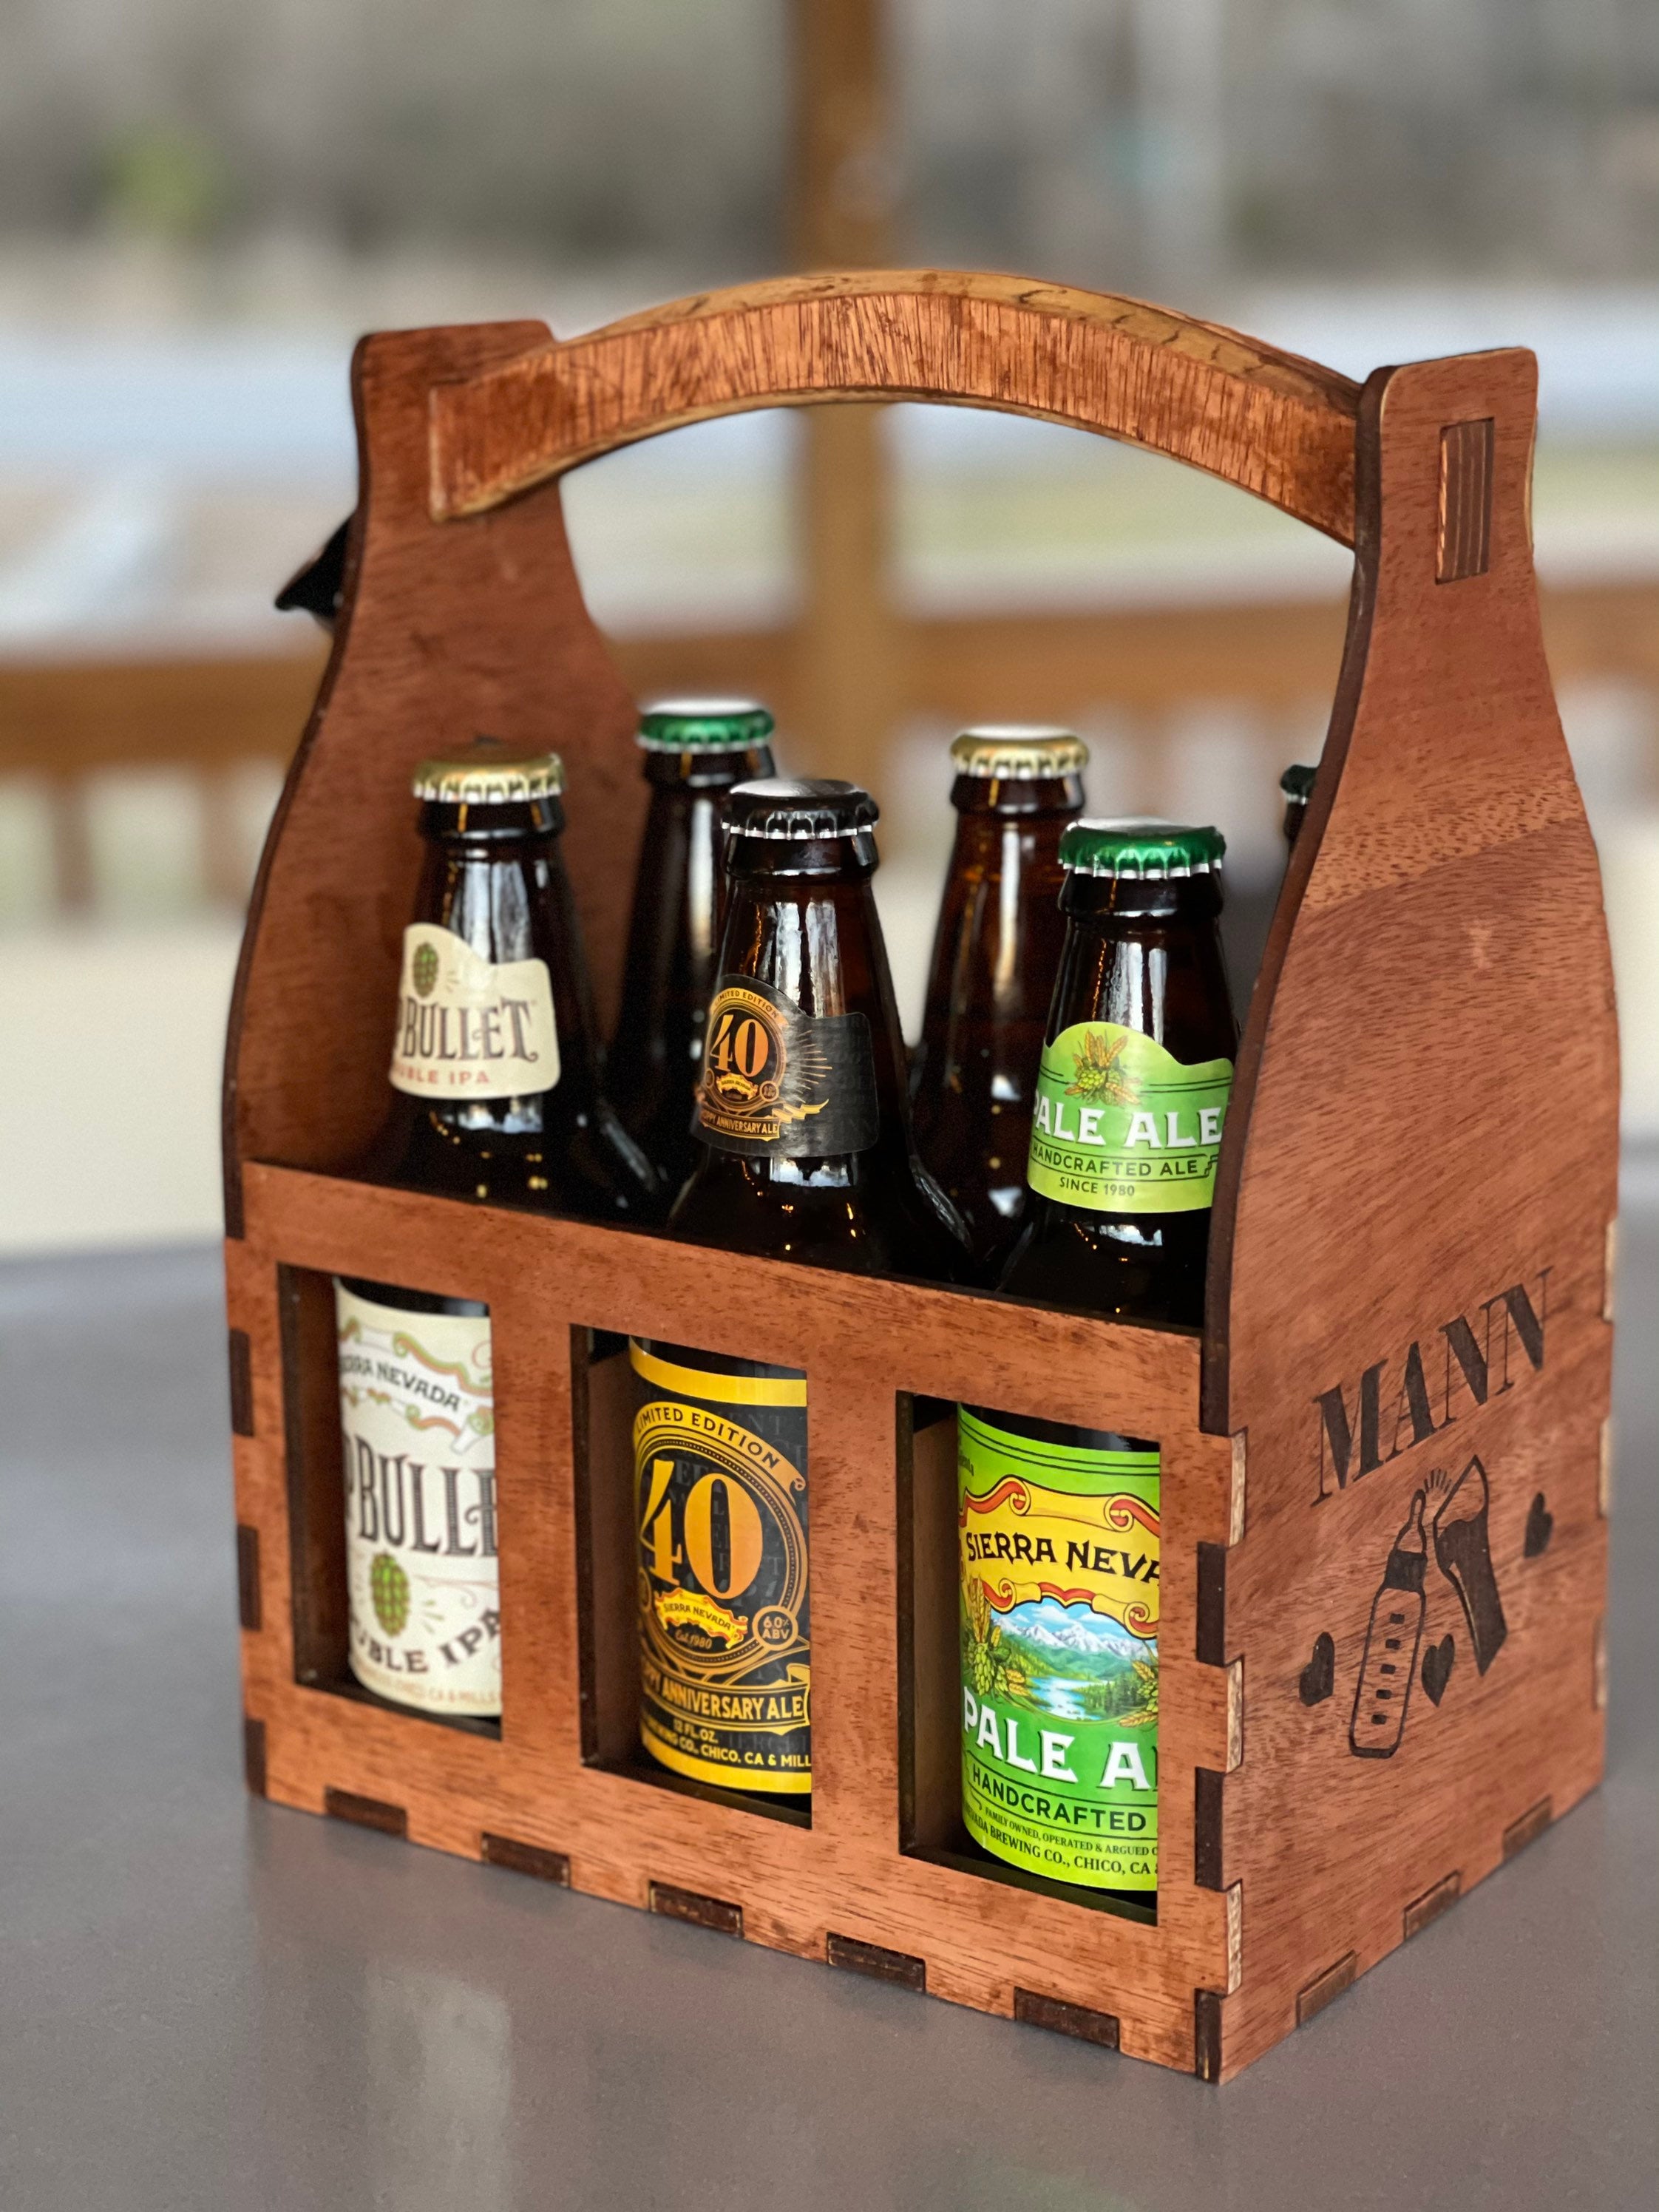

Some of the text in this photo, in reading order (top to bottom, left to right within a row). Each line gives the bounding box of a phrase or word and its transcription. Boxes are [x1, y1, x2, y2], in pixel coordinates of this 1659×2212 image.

[742, 992, 779, 1019] EDITION
[402, 997, 538, 1062] BULLET
[709, 1014, 770, 1077] 40
[449, 1070, 490, 1085] IPA
[716, 1116, 761, 1133] ANNIVERSARY
[761, 1123, 778, 1134] ALE
[1124, 1107, 1222, 1149] ALE
[1033, 1142, 1198, 1177] HANDCRAFTED ALE
[1059, 1176, 1136, 1197] SINCE 1980
[376, 1360, 462, 1412] NEVADA
[1310, 1266, 1554, 1507] MANN
[637, 1407, 683, 1436] LIMITED
[691, 1413, 781, 1470] EDITION
[639, 1459, 764, 1600] 40
[966, 1531, 1056, 1566] SIERRA
[693, 1607, 732, 1631] NEVADA
[761, 1629, 790, 1639] ABV
[662, 1676, 764, 1720] ANNIVERSARY
[767, 1695, 804, 1720] ALE
[963, 1686, 1079, 1783] PALE
[744, 1752, 764, 1765] CA
[768, 1754, 776, 1765] &
[972, 1763, 1147, 1831] HANDCRAFTED
[985, 1807, 1008, 1827] FAMILY
[1009, 1820, 1041, 1841] OWNED,
[1042, 1832, 1093, 1851] OPERATED
[1095, 1843, 1102, 1853] &
[1105, 1845, 1150, 1856] ARGUED
[990, 1824, 1041, 1858] BREWING
[1073, 1855, 1126, 1876] CHICO,
[1130, 1862, 1151, 1875] CA
